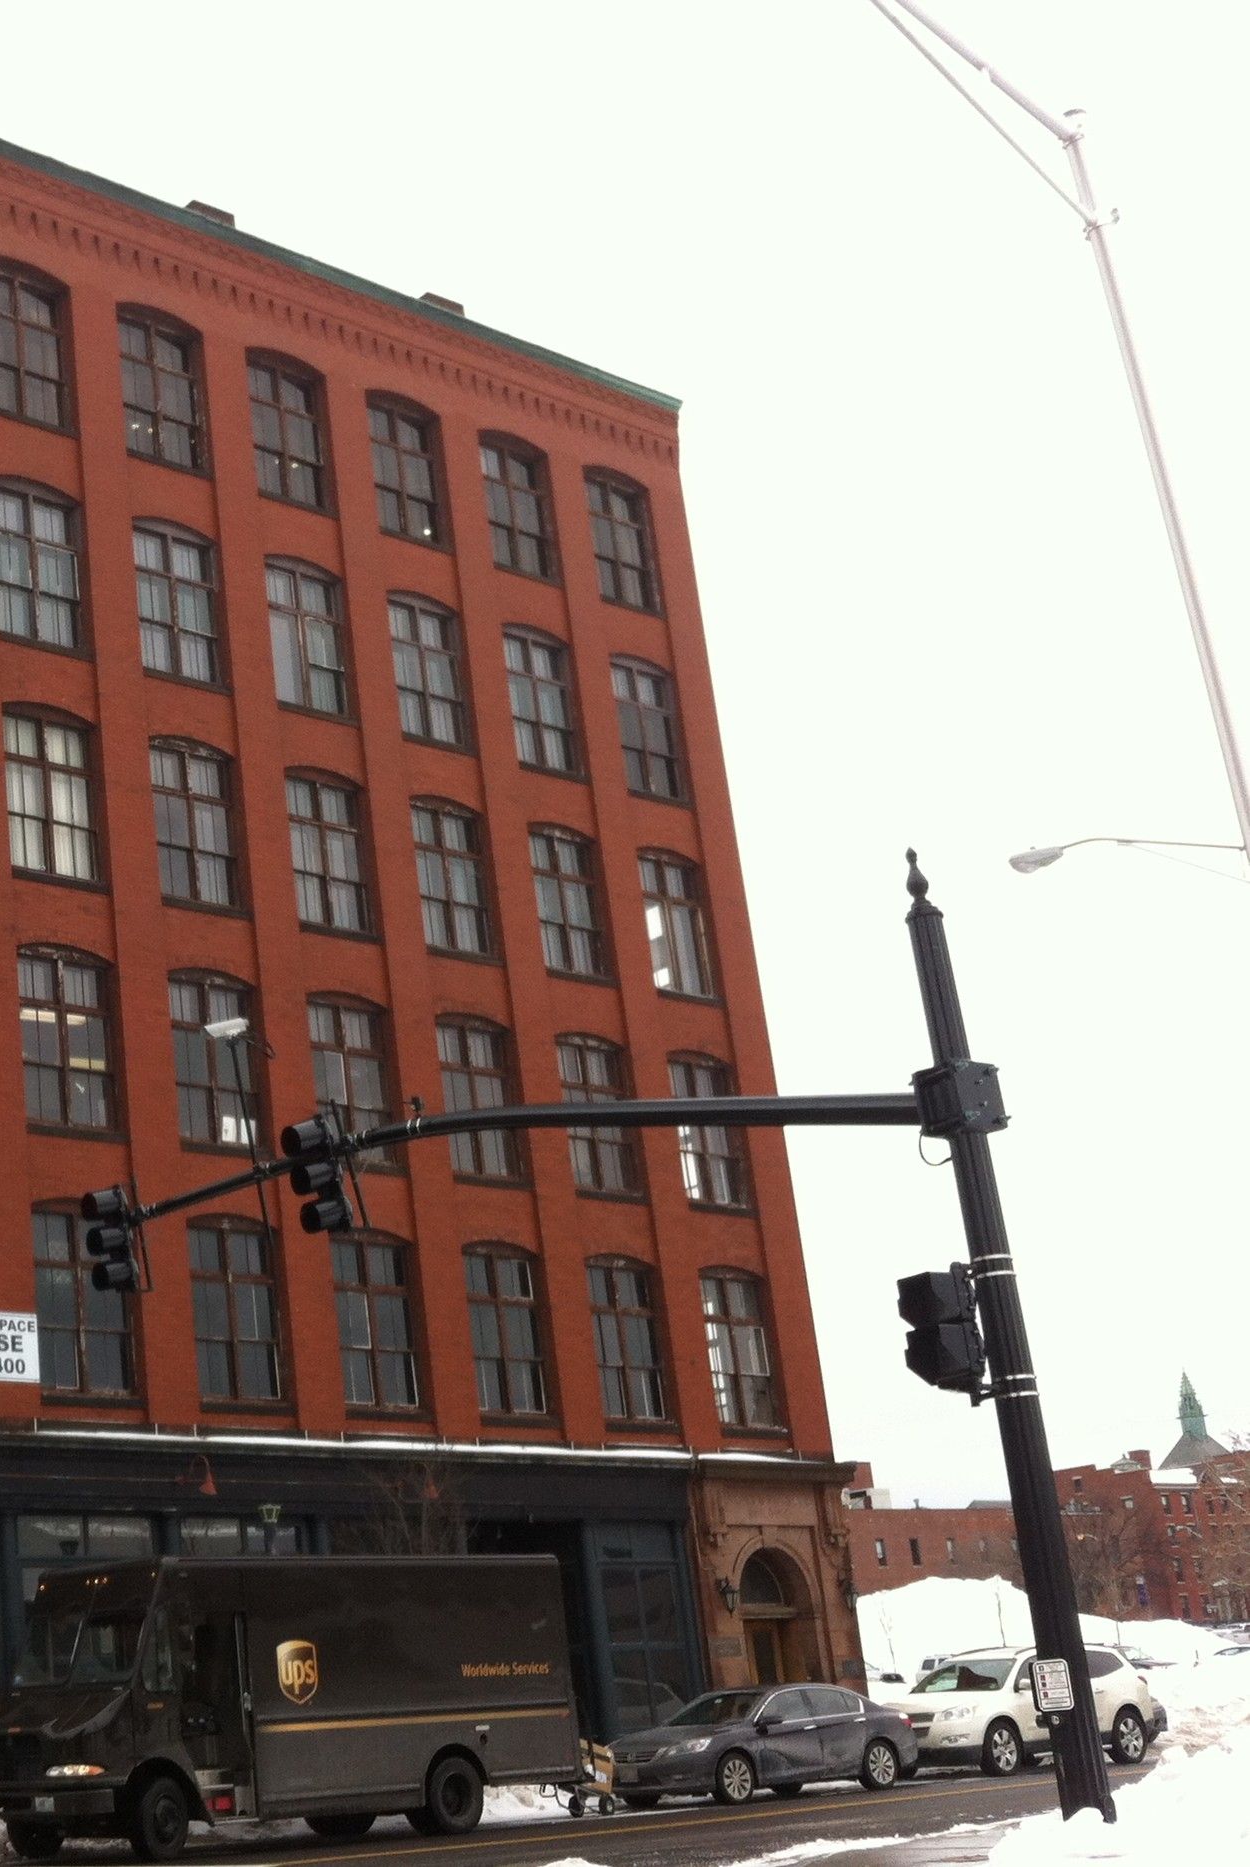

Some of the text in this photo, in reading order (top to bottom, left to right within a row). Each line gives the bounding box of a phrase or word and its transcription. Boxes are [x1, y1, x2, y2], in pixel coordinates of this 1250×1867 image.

[281, 1659, 316, 1695] ups
[461, 1662, 550, 1677] Worldwide Services
